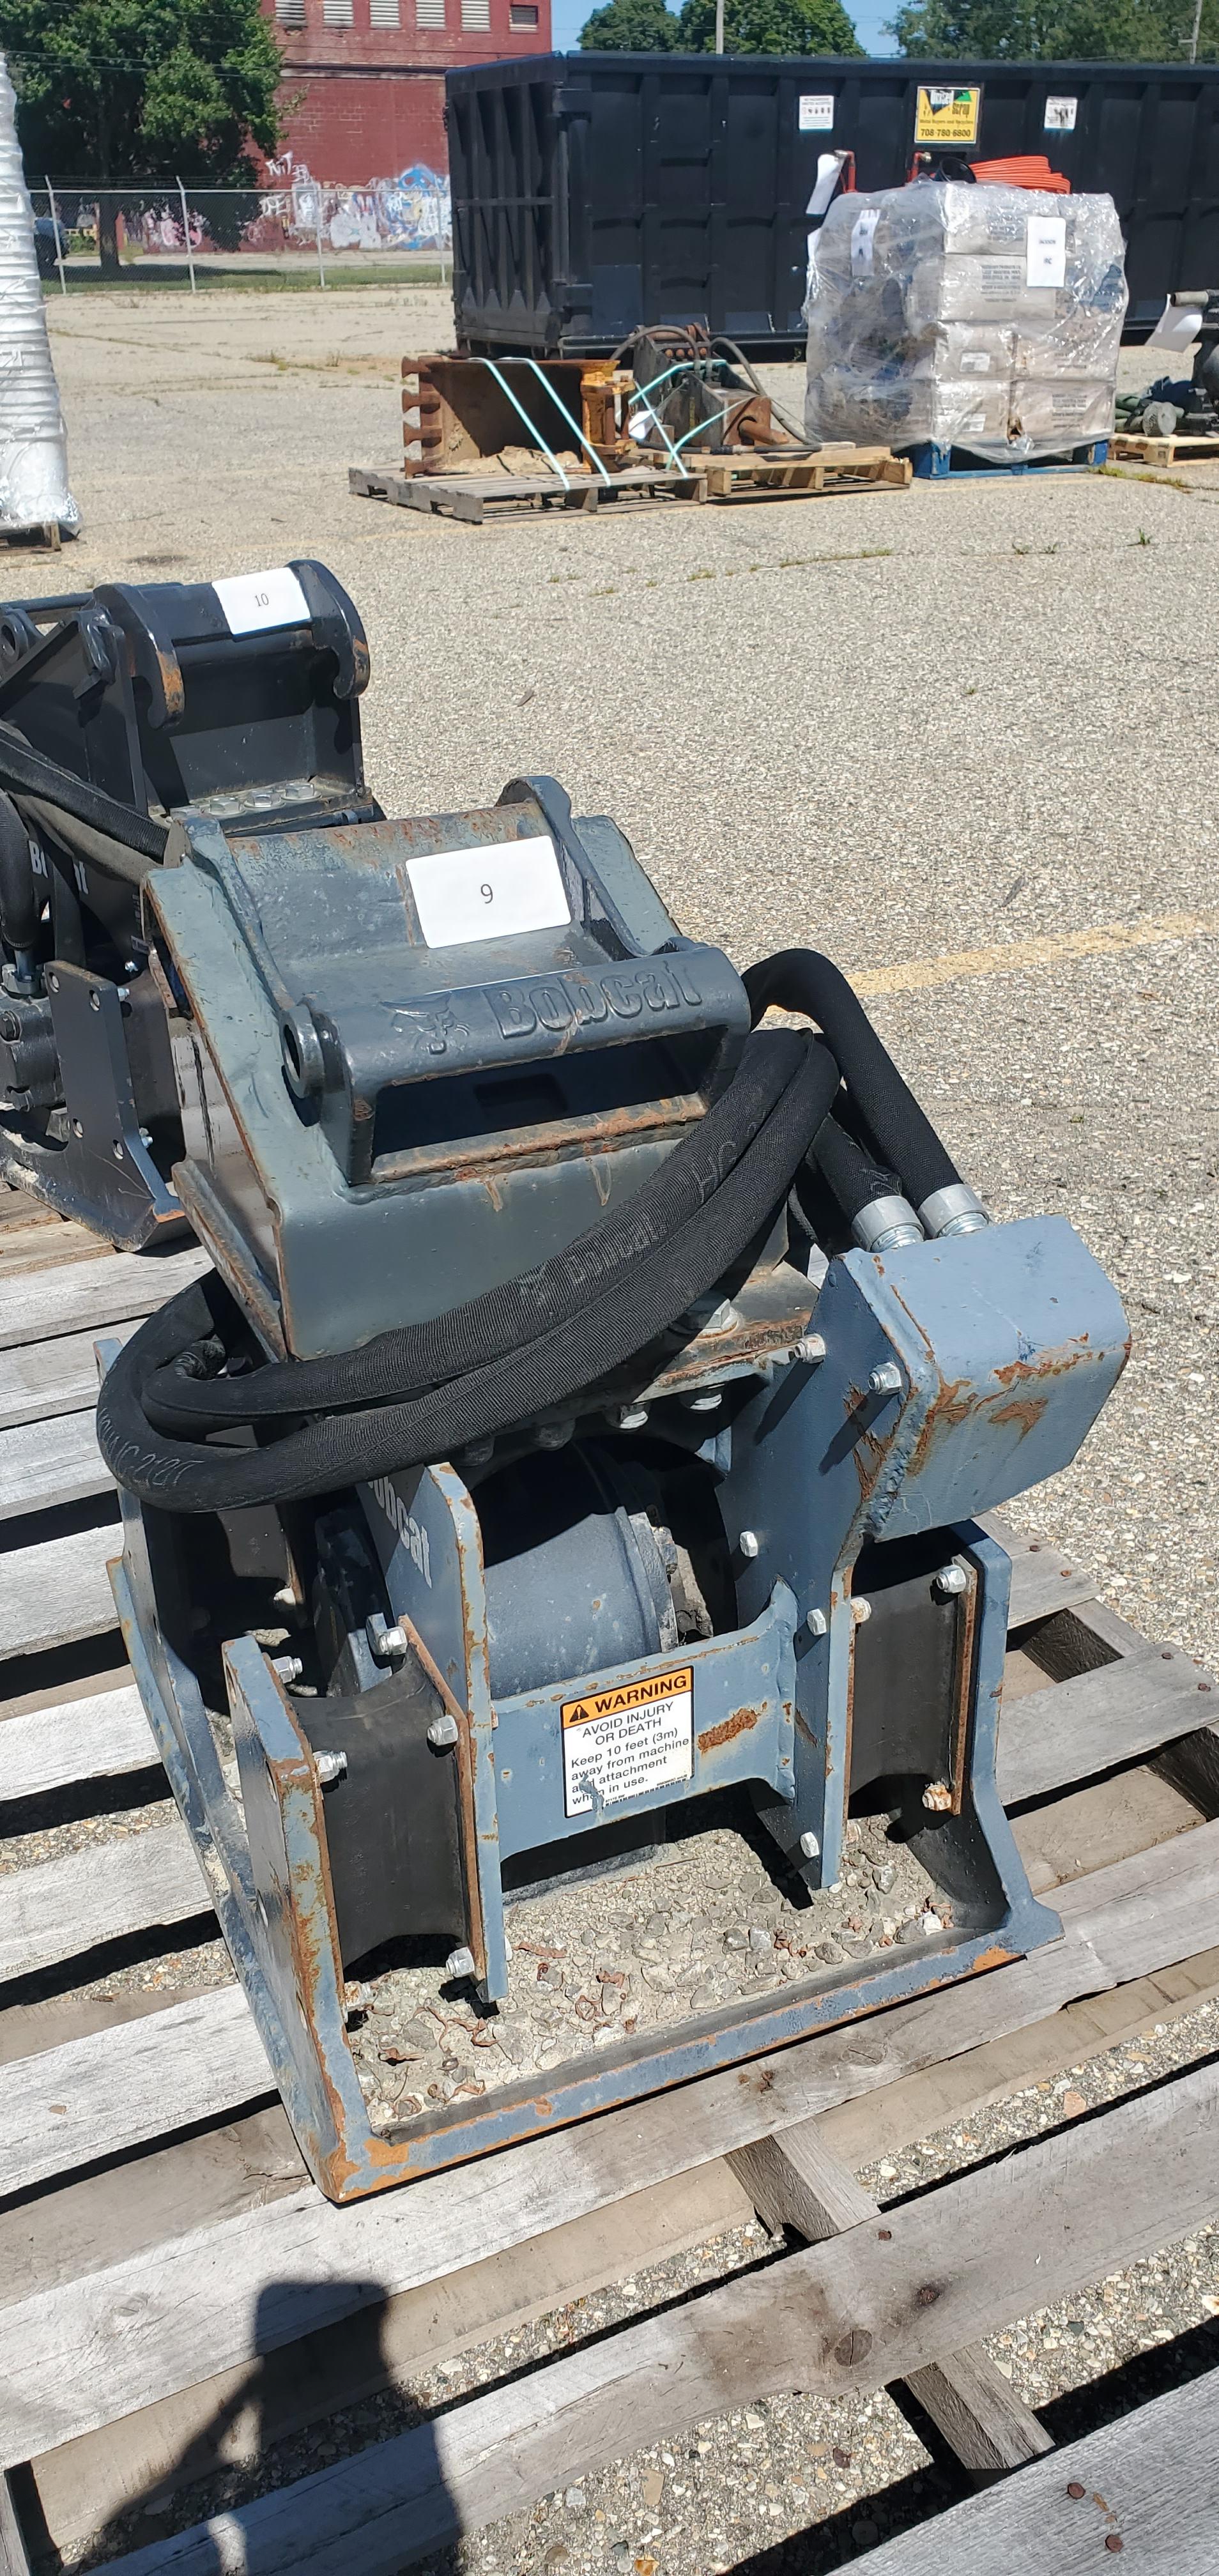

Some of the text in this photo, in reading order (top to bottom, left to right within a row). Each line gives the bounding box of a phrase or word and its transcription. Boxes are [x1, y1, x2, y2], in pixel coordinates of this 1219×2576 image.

[255, 593, 269, 607] 10
[480, 884, 493, 904] 9
[482, 960, 703, 1039] Bobcat
[367, 1476, 433, 1590] obcat
[595, 1675, 687, 1713] WARNING
[583, 1701, 674, 1738] AVOID INJURY
[595, 1717, 662, 1745] OR DEATH
[571, 1727, 678, 1768] Keep 10 feet (3m)
[572, 1738, 689, 1781] away from machine
[599, 1756, 668, 1784] attachment
[609, 1784, 619, 1793] in
[624, 1776, 648, 1789] use.
